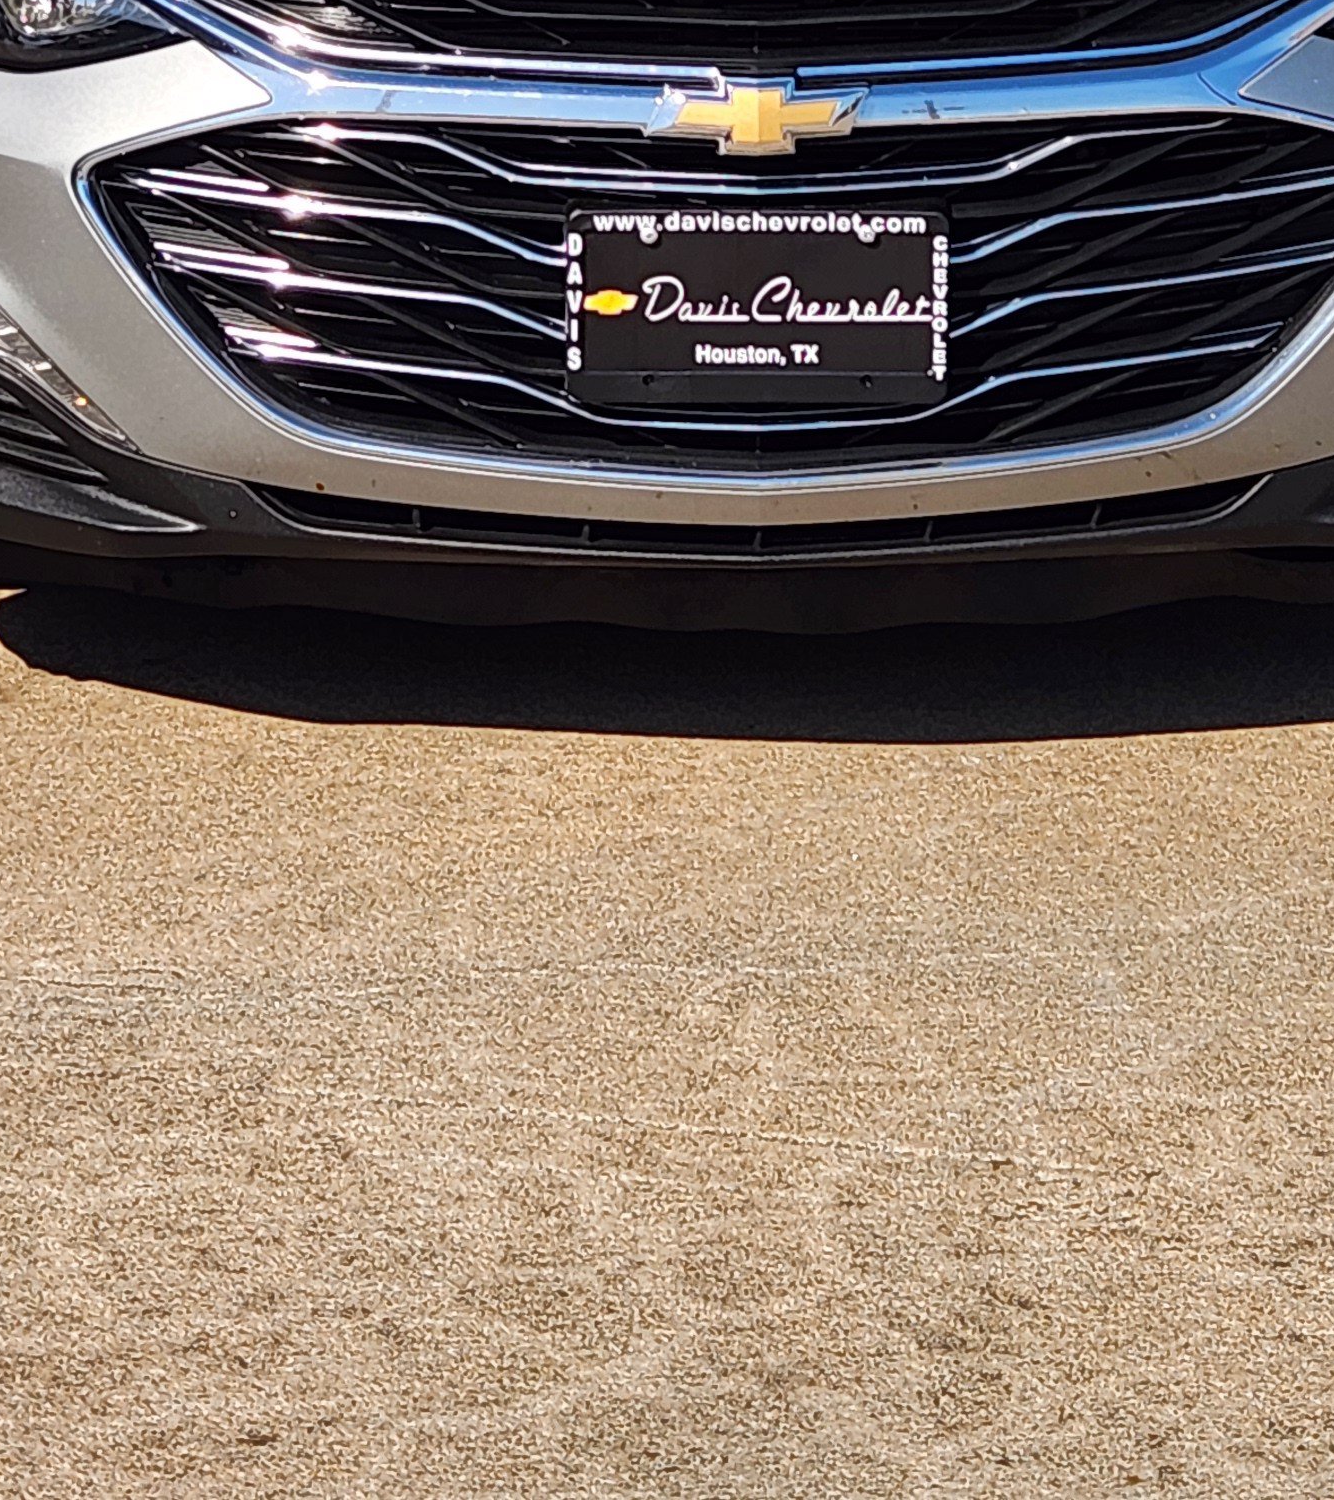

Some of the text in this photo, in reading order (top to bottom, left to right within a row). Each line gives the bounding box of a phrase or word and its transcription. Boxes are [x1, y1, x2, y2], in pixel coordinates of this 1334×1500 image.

[592, 211, 927, 235] www.davischevroletcom
[566, 232, 583, 371] DAVIS
[642, 275, 934, 322] Davis Chevrolet
[931, 235, 949, 381] CHEVROLET
[695, 343, 819, 367] Houston, TX
